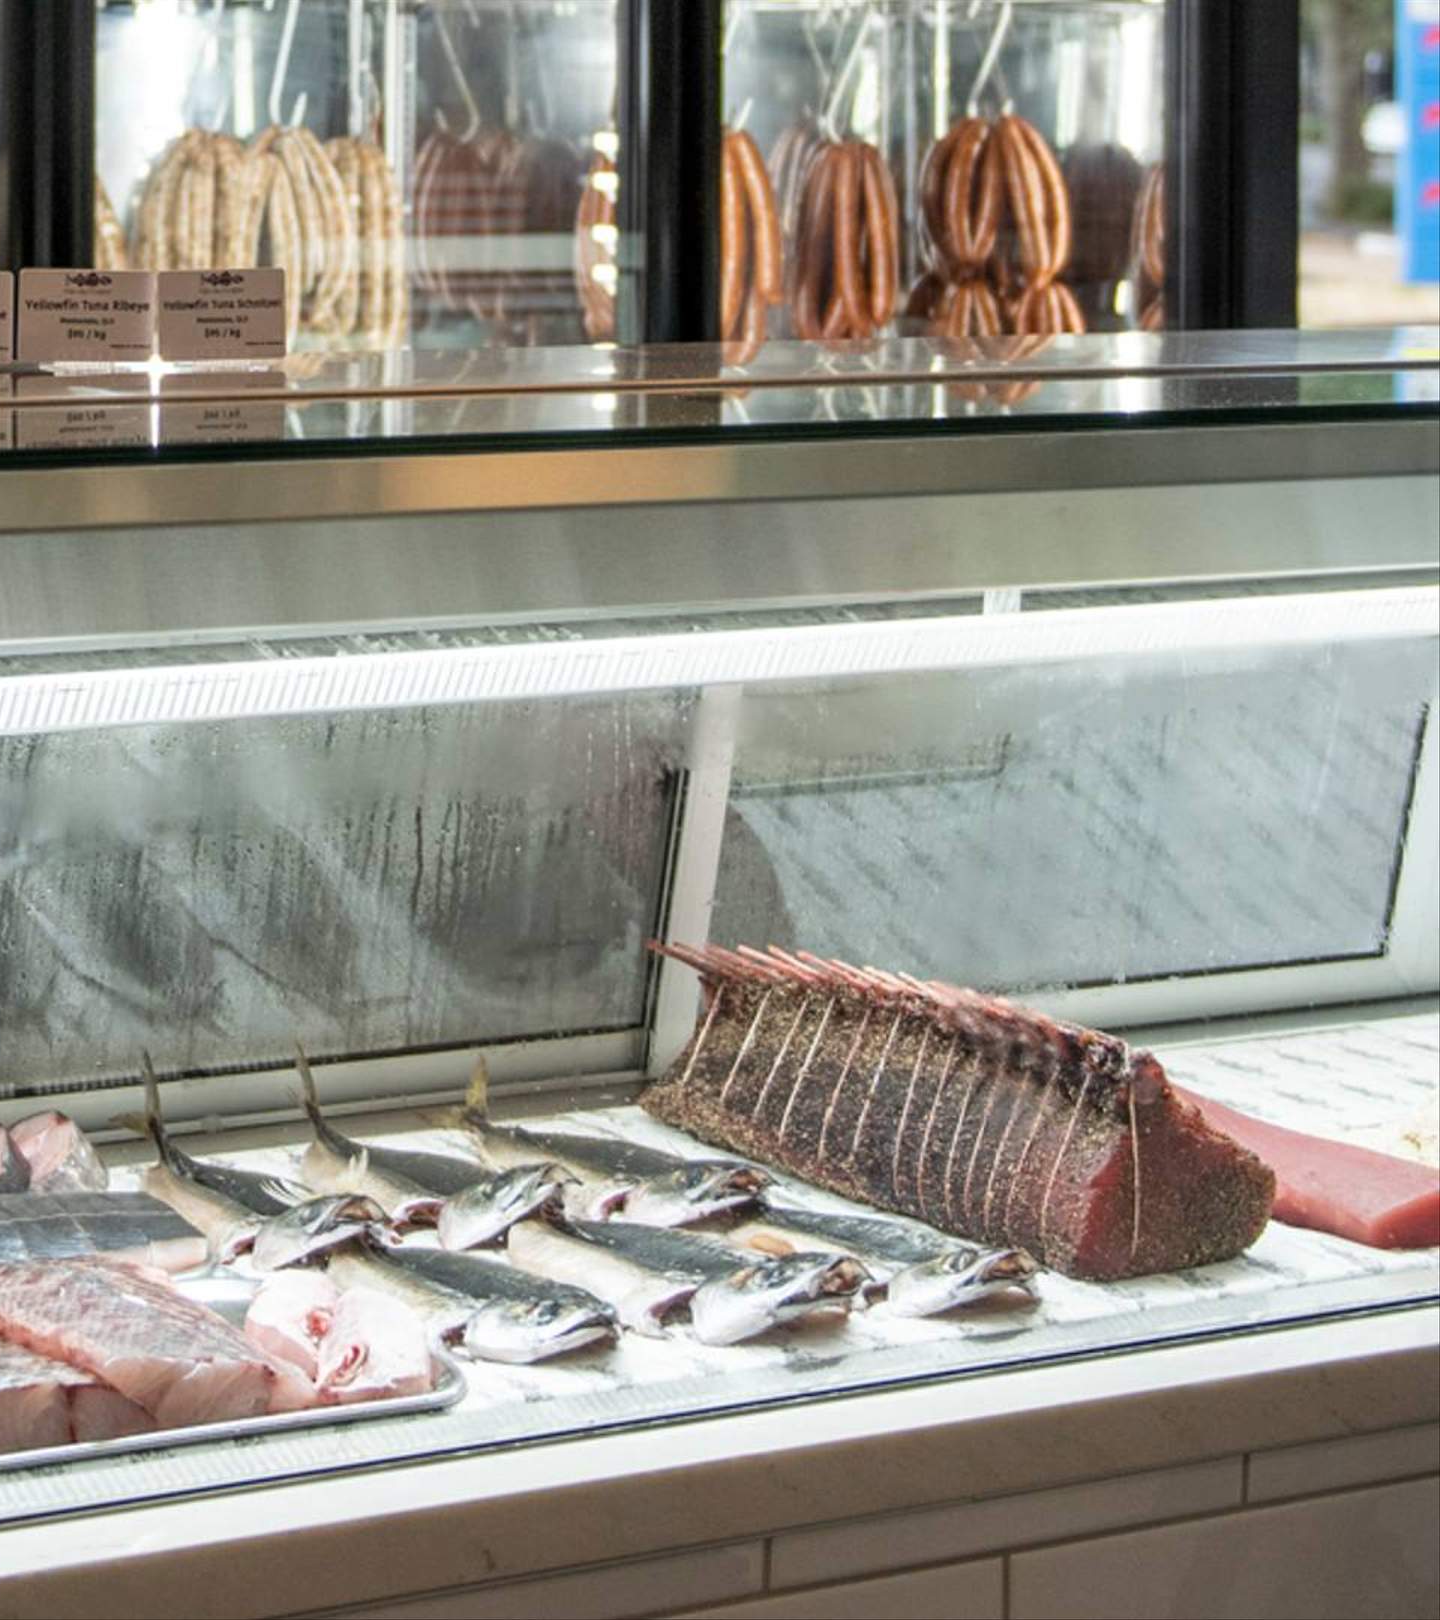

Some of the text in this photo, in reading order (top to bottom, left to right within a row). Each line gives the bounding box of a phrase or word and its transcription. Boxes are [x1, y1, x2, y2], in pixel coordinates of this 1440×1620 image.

[25, 299, 150, 313] Yellowfin Tuna Ribeye
